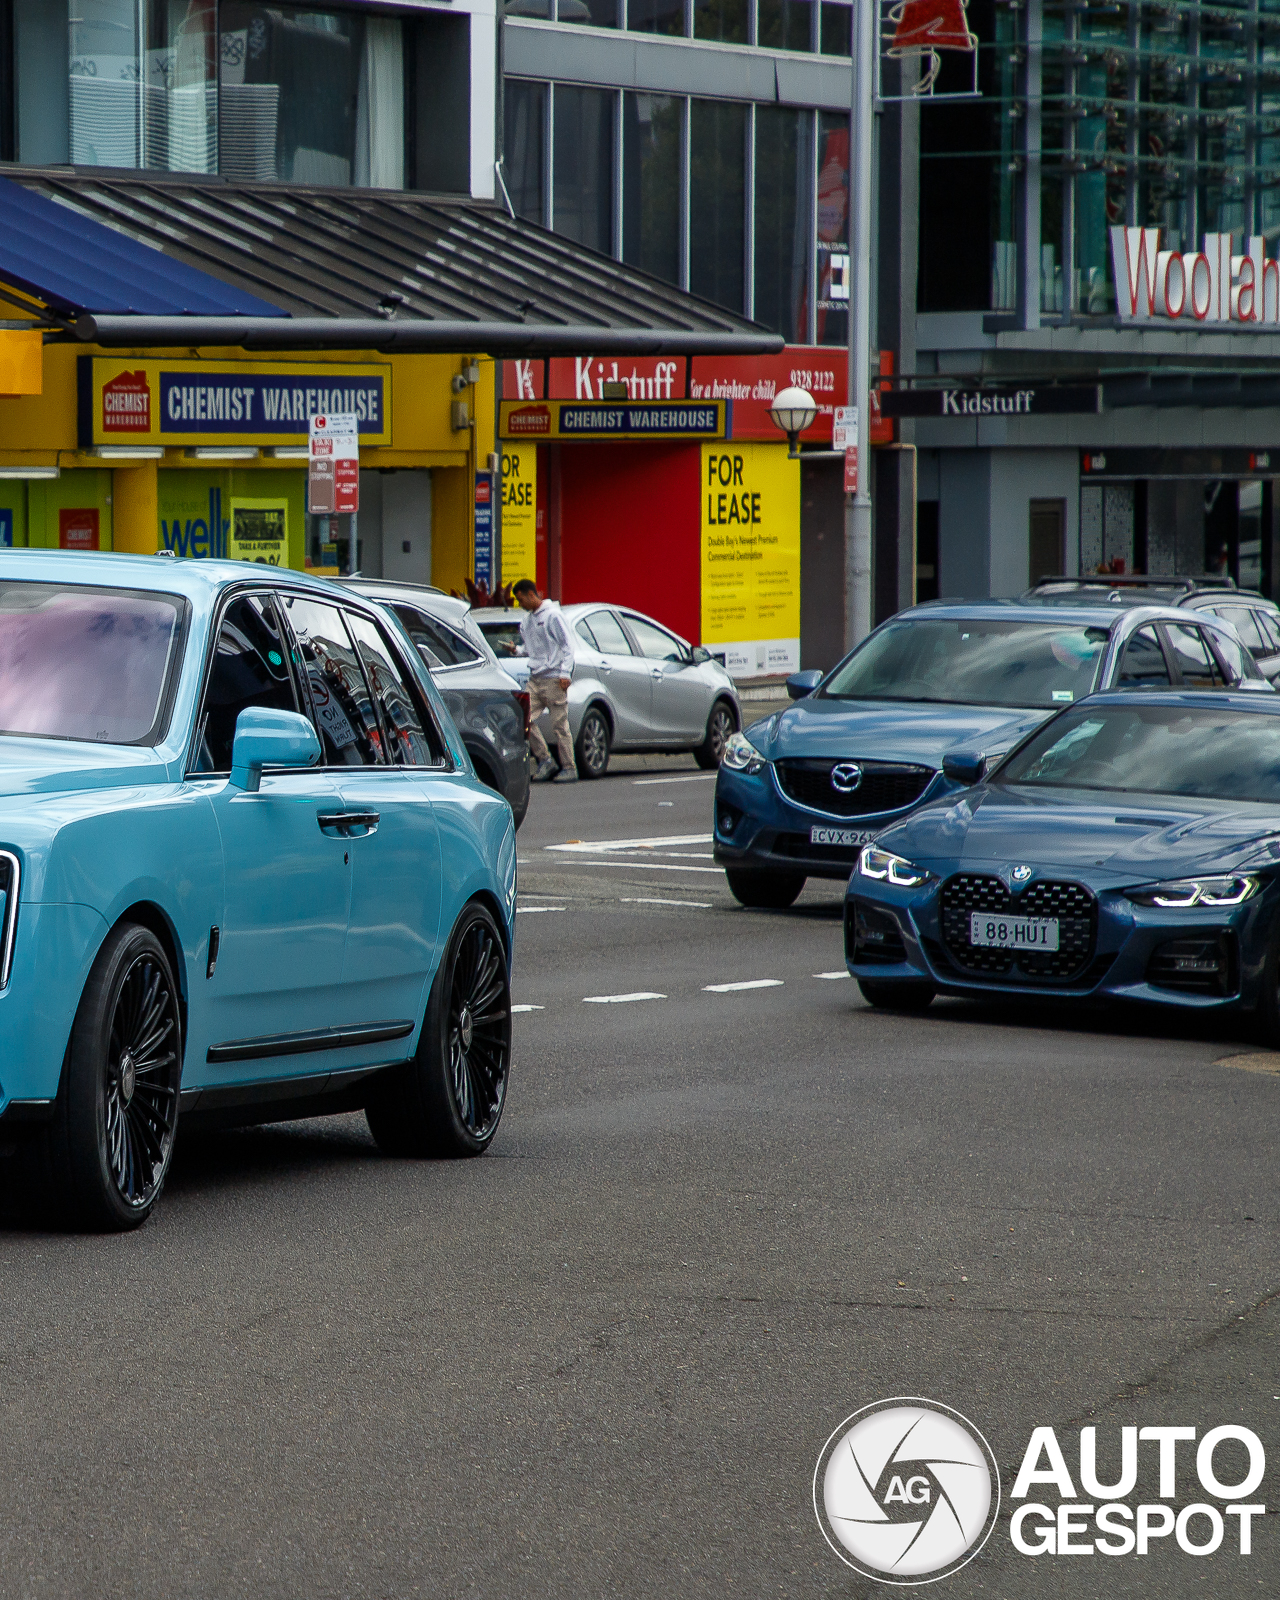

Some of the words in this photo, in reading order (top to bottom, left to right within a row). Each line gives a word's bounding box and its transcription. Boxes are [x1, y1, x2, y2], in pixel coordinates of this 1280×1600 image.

[704, 385, 711, 398] a
[712, 379, 751, 399] brighter
[752, 380, 776, 400] child
[790, 369, 812, 390] 9328
[814, 371, 835, 391] 2122
[105, 392, 149, 412] CHEMIST
[168, 386, 255, 421] CHEMIST
[262, 388, 378, 422] WAREHOUSE
[942, 389, 1035, 415] Kidstuff
[564, 411, 624, 428] CHEMIST
[629, 410, 715, 428] WAREHOUSE
[502, 454, 520, 477] OR
[708, 455, 744, 487] FOR
[502, 482, 533, 506] EASE
[708, 492, 761, 525] LEASE
